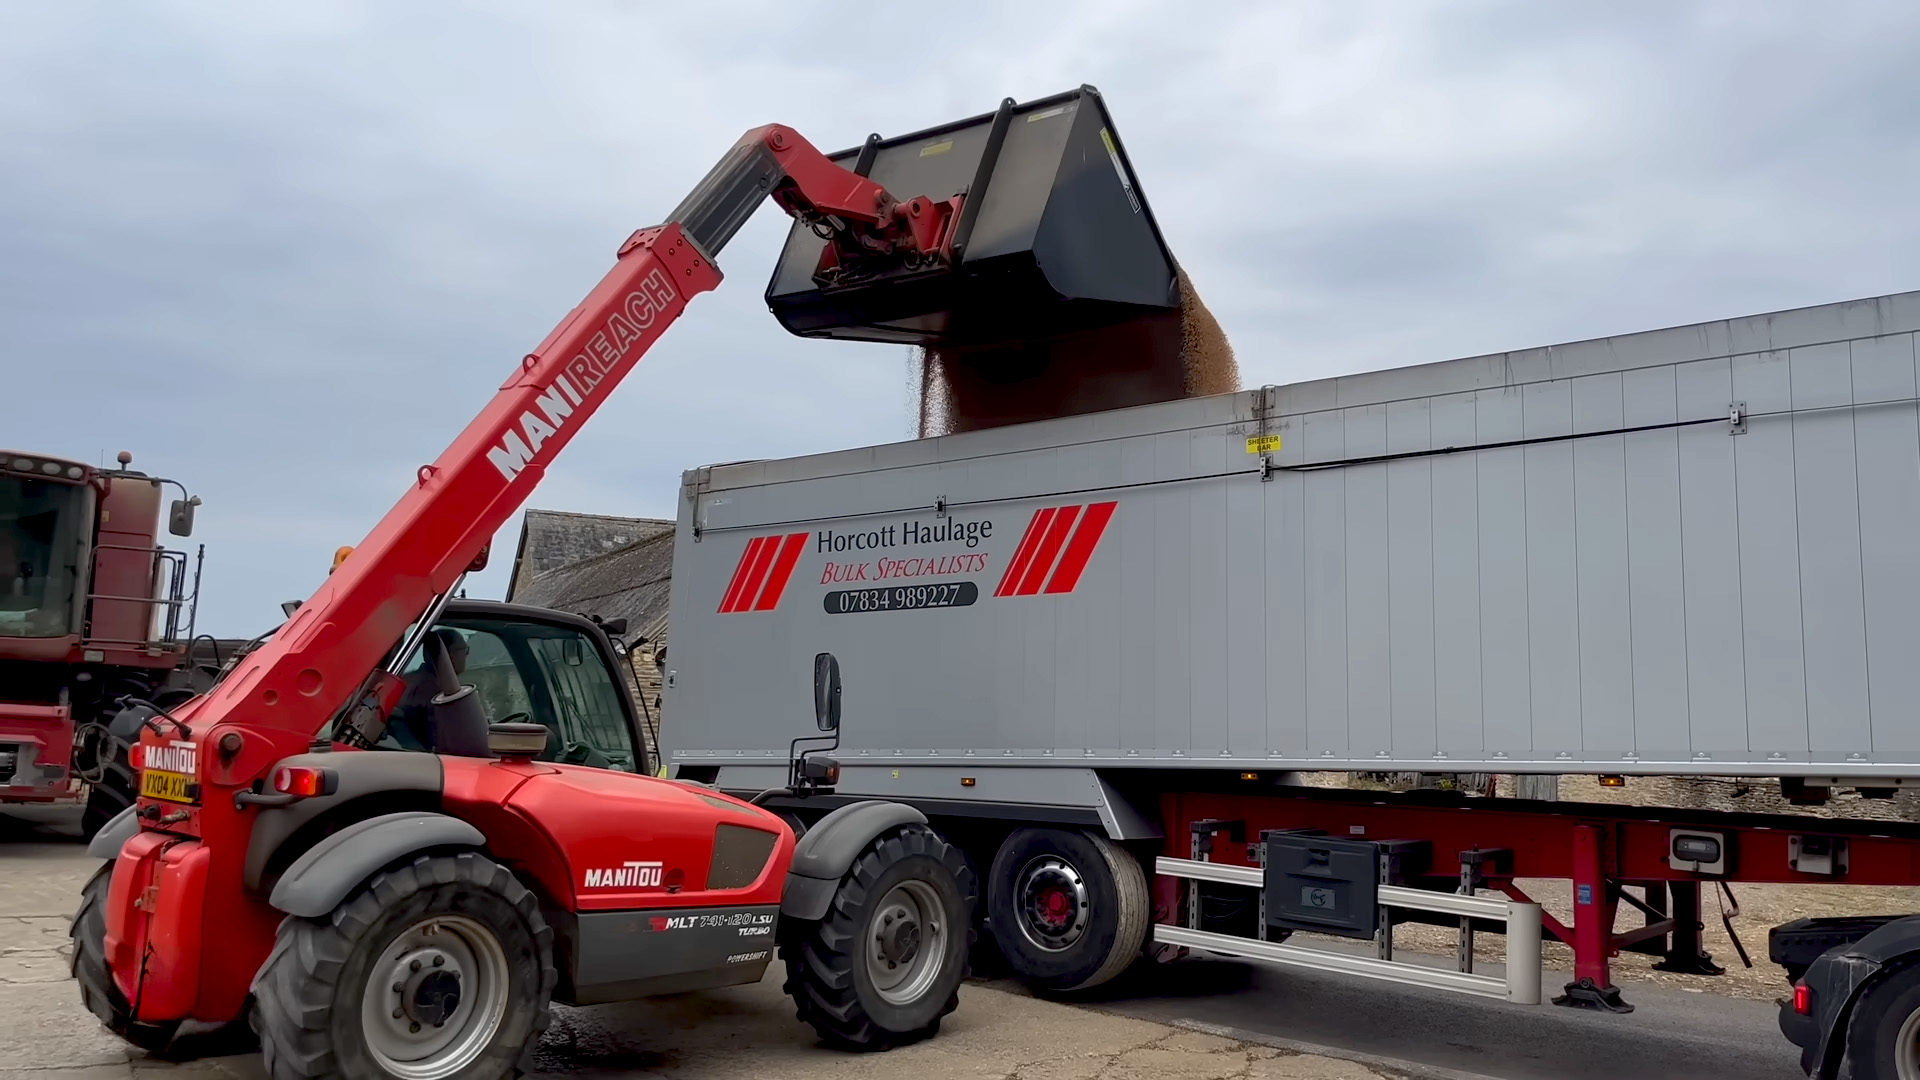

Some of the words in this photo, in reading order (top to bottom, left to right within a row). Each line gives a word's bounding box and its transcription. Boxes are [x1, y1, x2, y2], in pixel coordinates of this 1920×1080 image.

[486, 268, 675, 483] MANIREACH
[1248, 436, 1279, 446] SHEETER
[817, 523, 896, 553] Horcott
[902, 516, 993, 548] Haulage
[819, 561, 871, 585] BULK
[873, 552, 989, 581] SPECIALISTS
[839, 590, 890, 612] 07834
[896, 584, 960, 609] 989227
[145, 740, 197, 774] MANITOU
[146, 773, 169, 796] VX04
[170, 776, 194, 798] XX
[584, 861, 663, 887] MANITOU
[665, 916, 699, 930] MLT
[752, 915, 774, 924] LSU
[738, 926, 770, 936] TURBO
